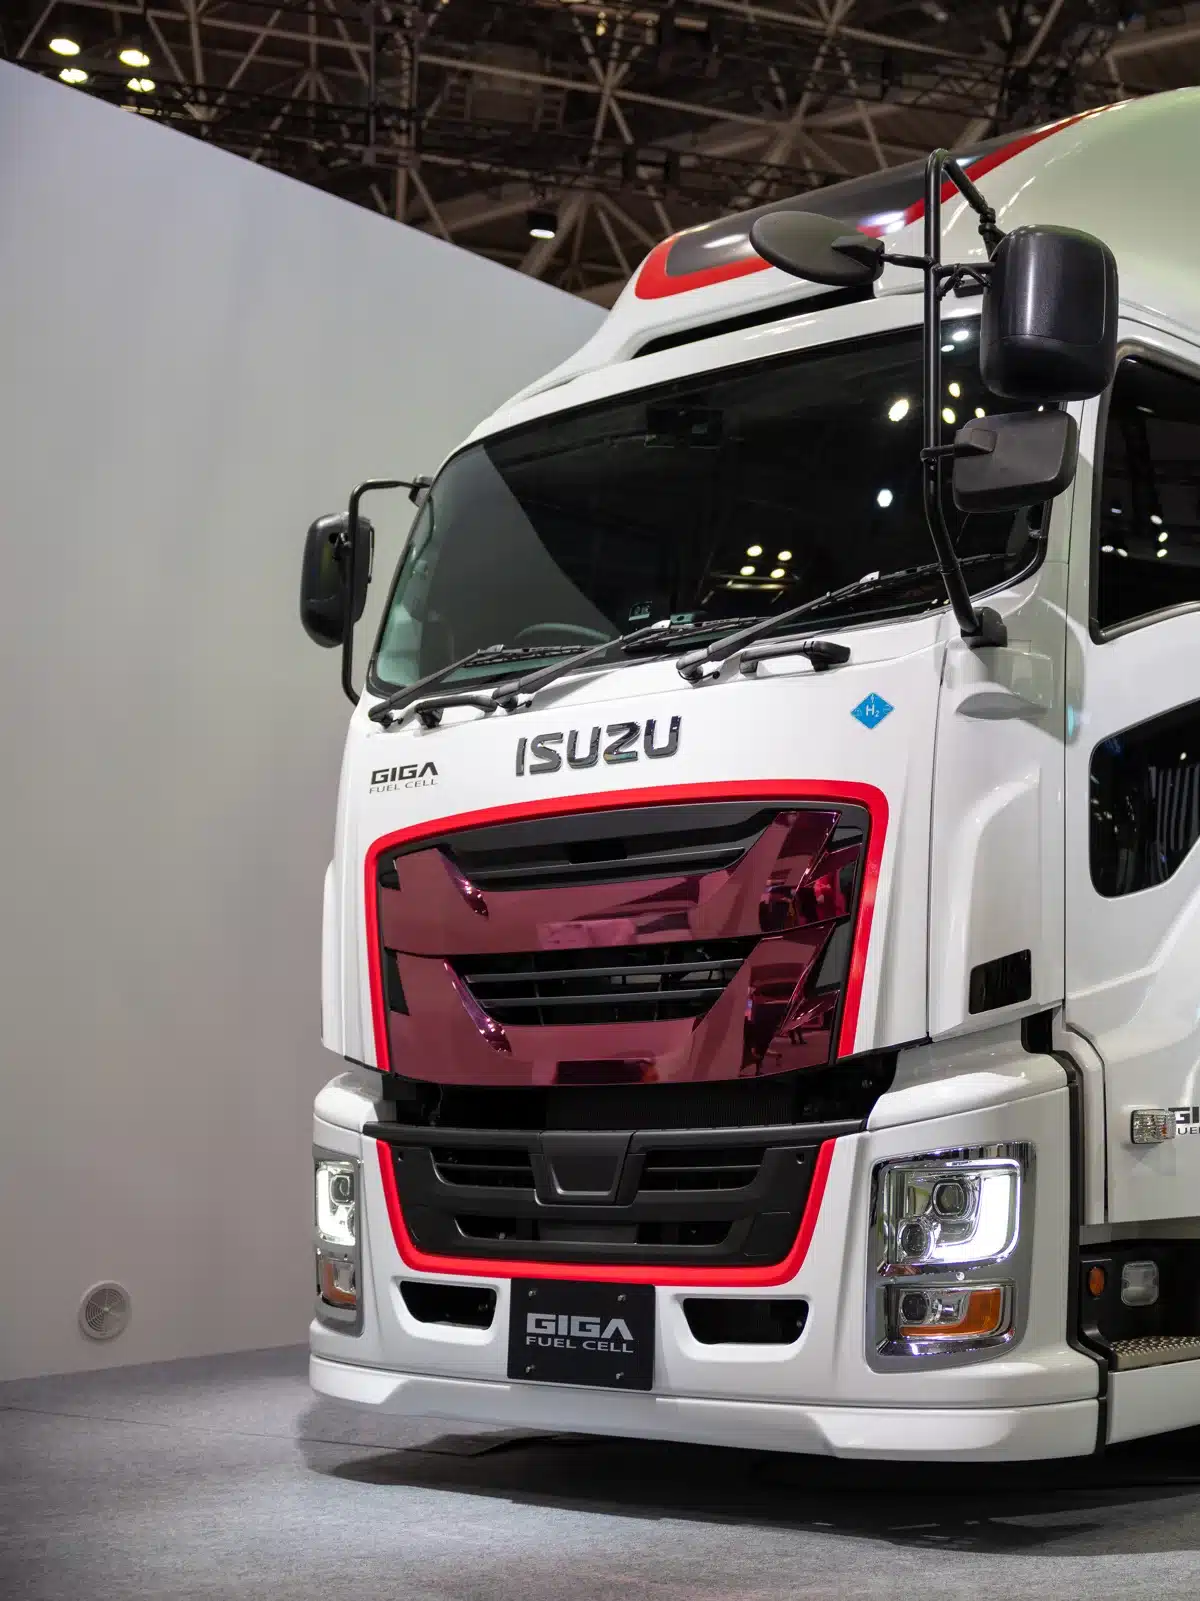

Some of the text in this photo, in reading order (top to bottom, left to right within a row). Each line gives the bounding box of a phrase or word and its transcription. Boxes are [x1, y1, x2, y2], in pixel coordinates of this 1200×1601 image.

[516, 715, 681, 777] ISUZU
[370, 761, 439, 785] GIGA
[369, 778, 438, 794] FUEL CELL
[526, 1312, 634, 1340] GIGA
[526, 1335, 634, 1353] FUEL CELL
